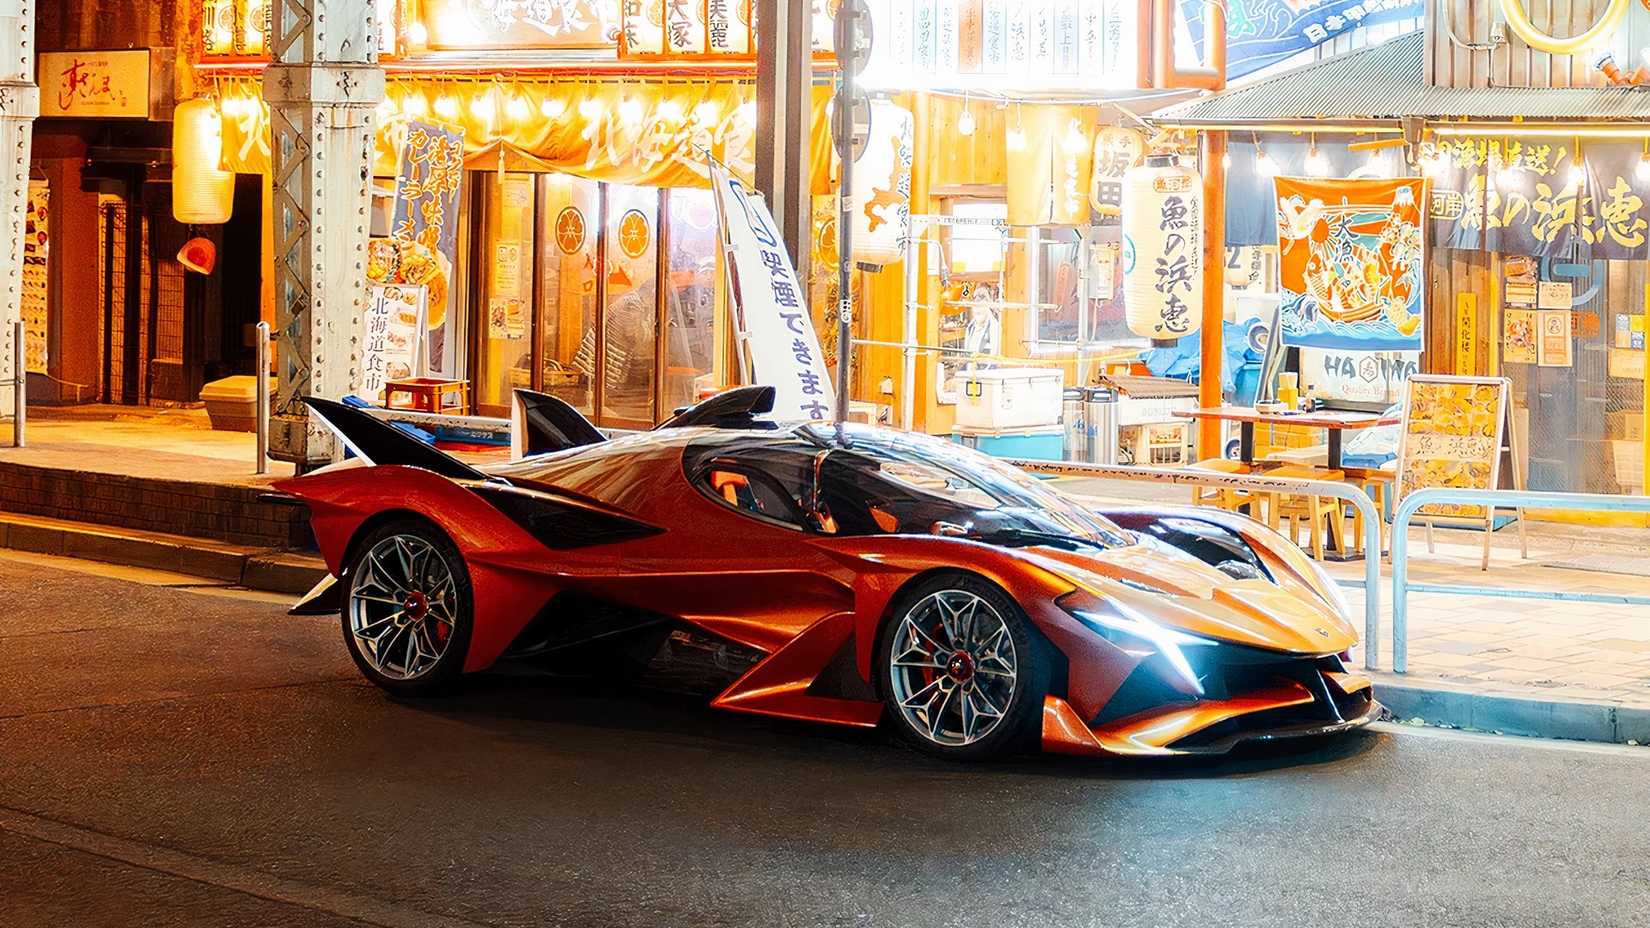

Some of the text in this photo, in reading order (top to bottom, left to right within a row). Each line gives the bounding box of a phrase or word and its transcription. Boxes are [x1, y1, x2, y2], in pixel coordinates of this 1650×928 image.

[1097, 151, 1129, 207] 坂田
[1461, 174, 1648, 248] 魚の浜恵
[1154, 195, 1193, 332] 魚の浜恵
[366, 297, 389, 391] 北海道食市
[760, 249, 828, 420] 喫煙できます
